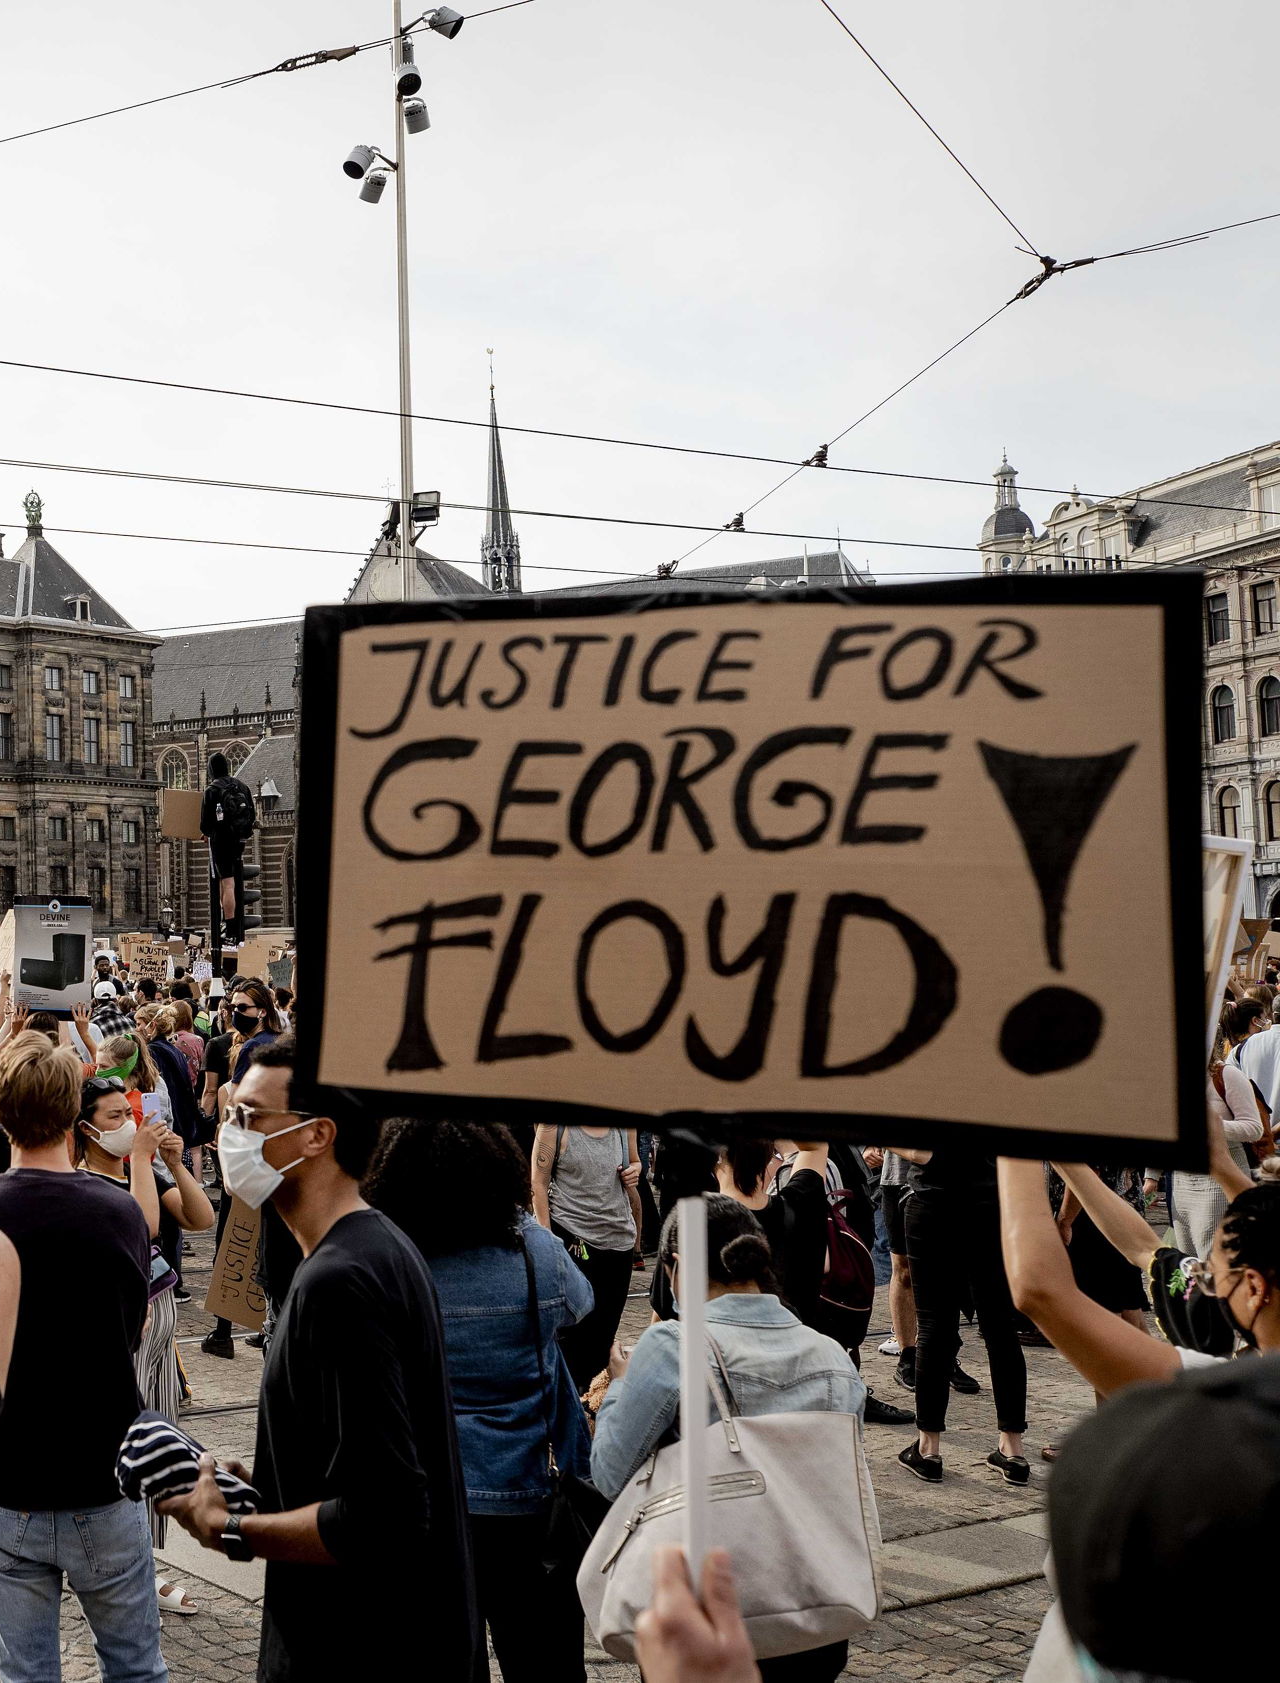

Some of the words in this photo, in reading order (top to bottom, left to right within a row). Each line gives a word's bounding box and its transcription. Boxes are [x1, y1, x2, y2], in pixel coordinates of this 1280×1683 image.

[349, 630, 761, 740] JUSTICE
[810, 619, 1045, 702] FOR
[362, 726, 951, 863] GEORGE
[39, 913, 71, 921] DEVINE
[373, 891, 960, 1084] FLOYD
